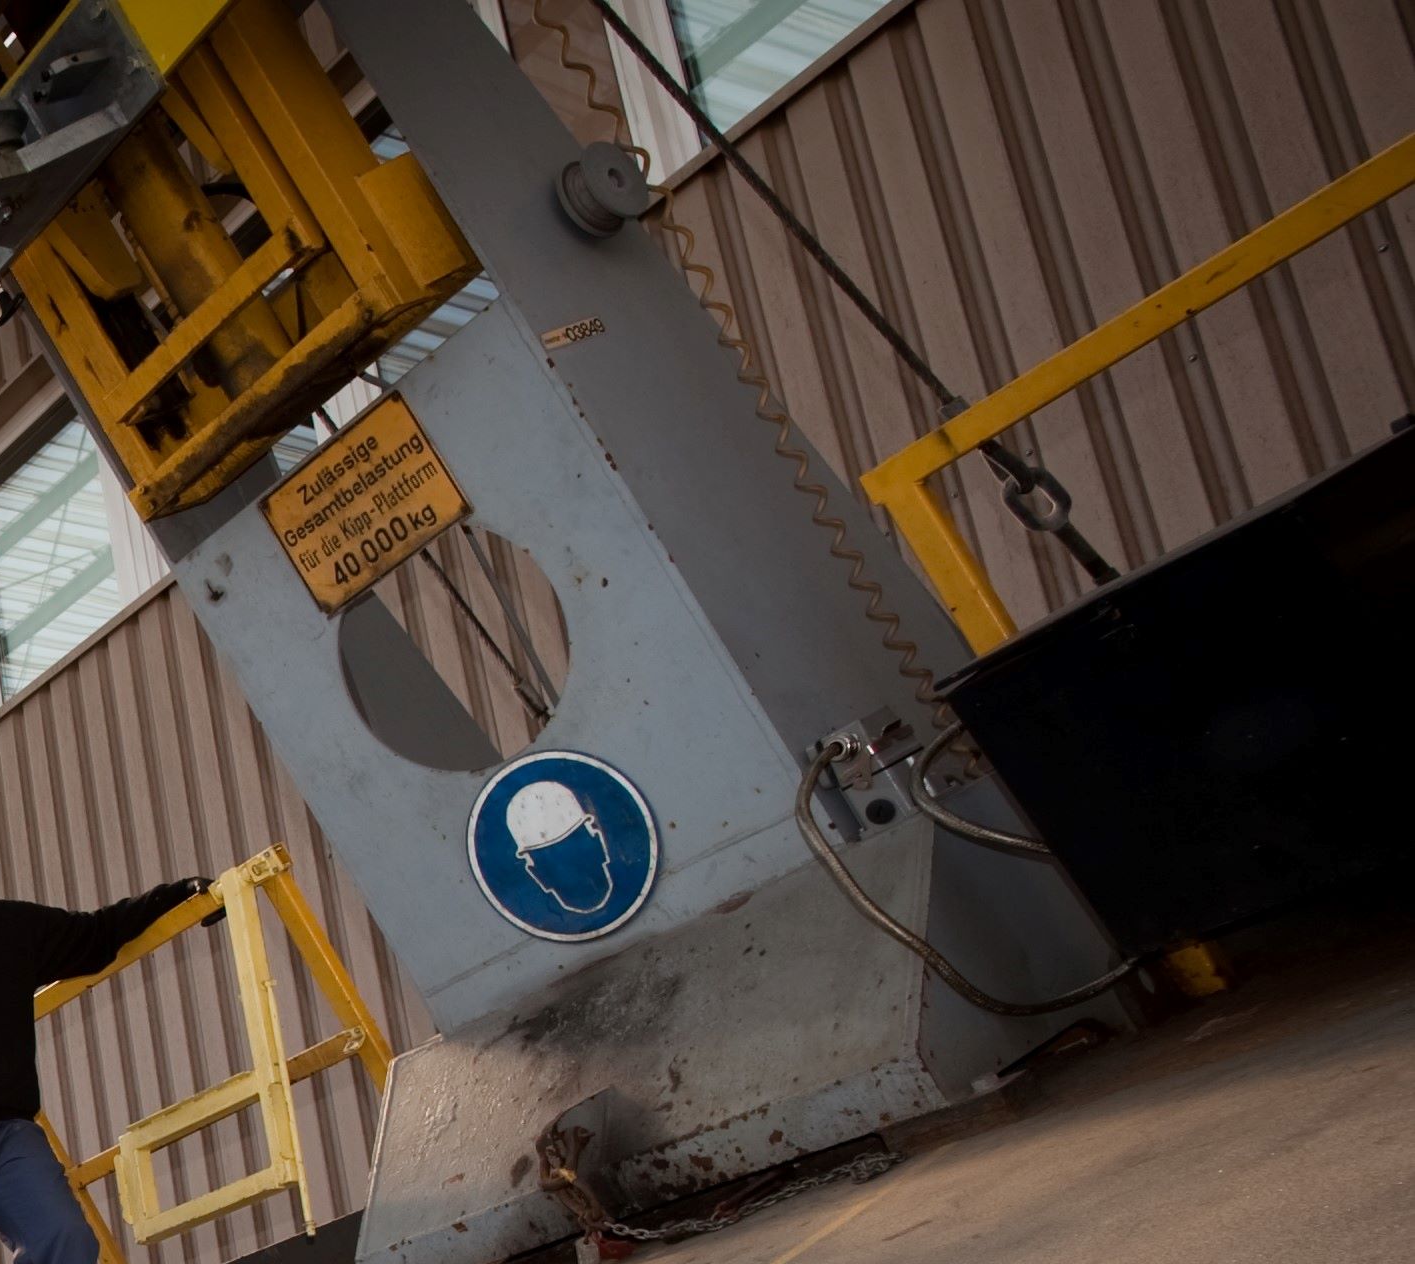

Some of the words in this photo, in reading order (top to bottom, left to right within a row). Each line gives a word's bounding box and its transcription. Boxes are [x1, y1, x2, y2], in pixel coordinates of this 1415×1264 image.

[284, 433, 425, 547] Gesamtbelastung
[296, 435, 379, 505] Zulässige
[299, 552, 322, 573] für
[321, 535, 342, 558] die
[338, 461, 438, 541] Kipp-Plattform
[409, 504, 438, 531] kg
